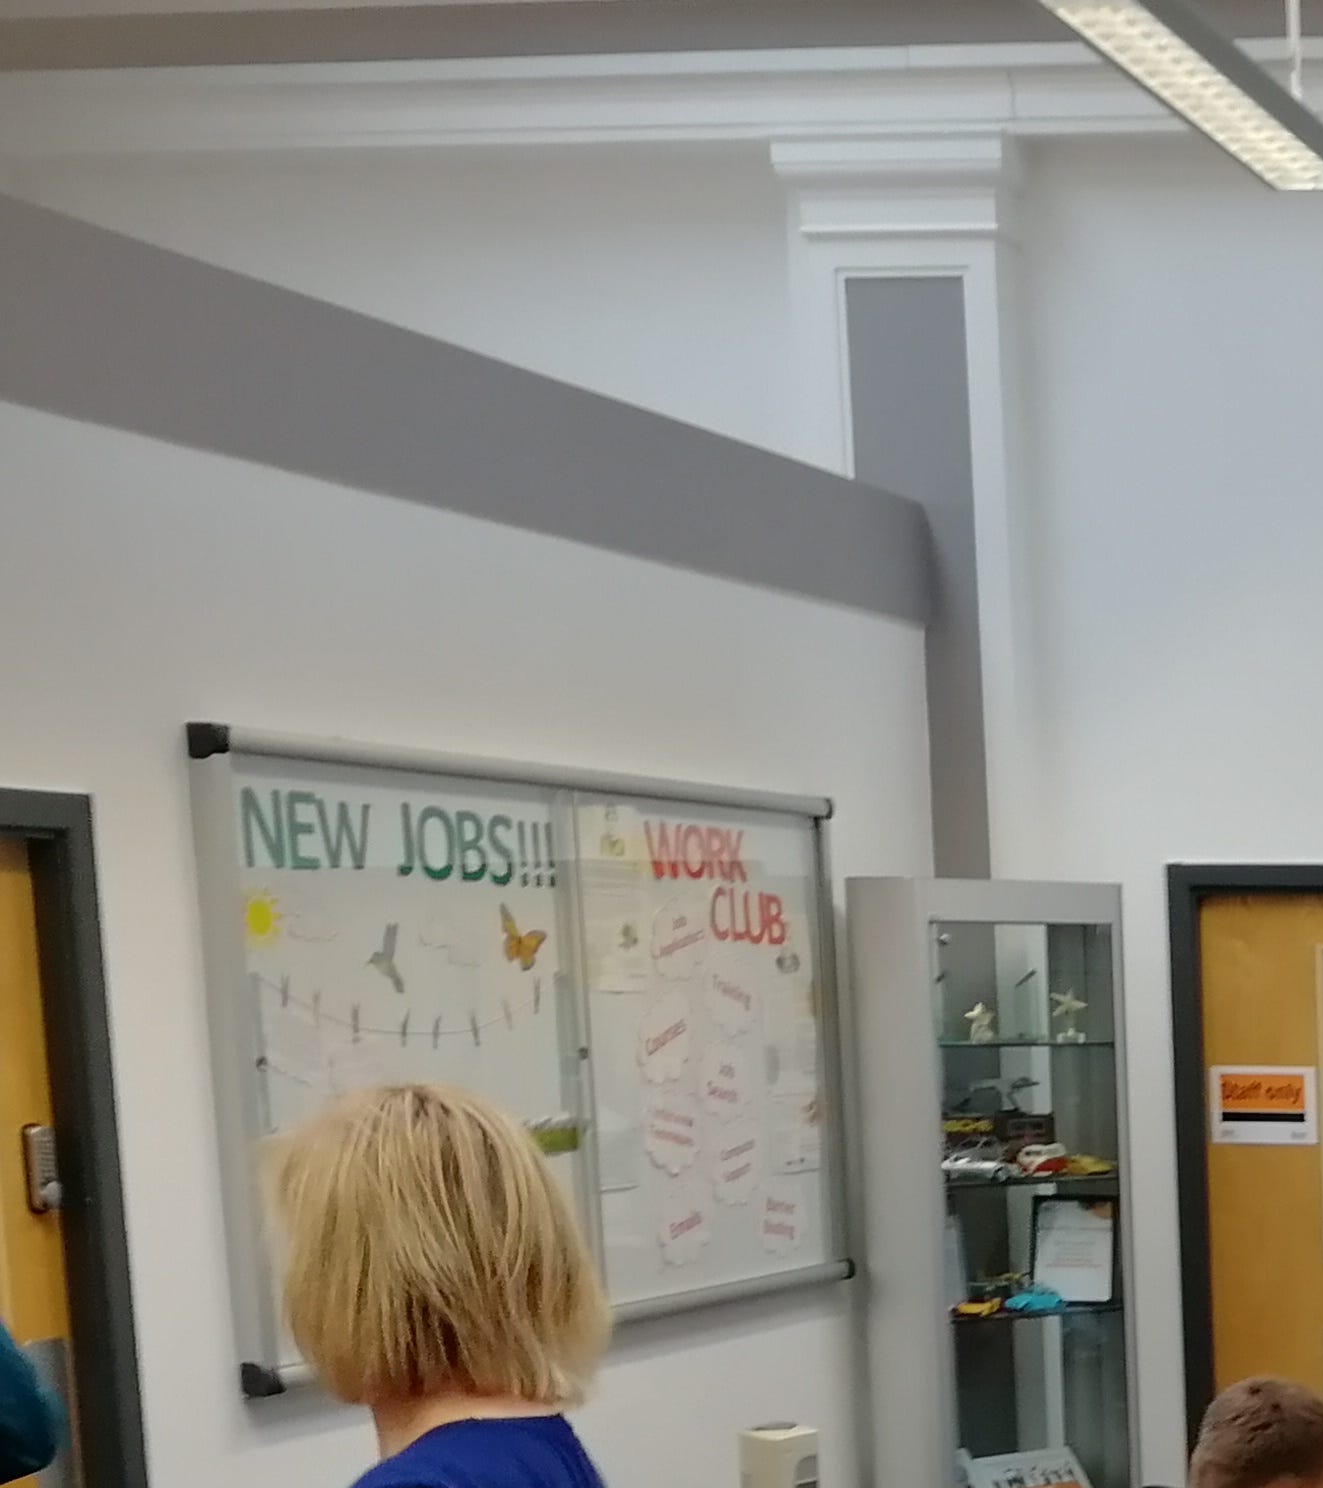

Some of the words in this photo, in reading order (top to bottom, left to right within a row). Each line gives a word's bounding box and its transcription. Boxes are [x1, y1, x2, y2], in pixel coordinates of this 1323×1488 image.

[240, 786, 370, 871] NEW
[396, 804, 557, 887] JOBS!!!
[644, 821, 749, 882] WORK
[710, 887, 786, 946] CLUB
